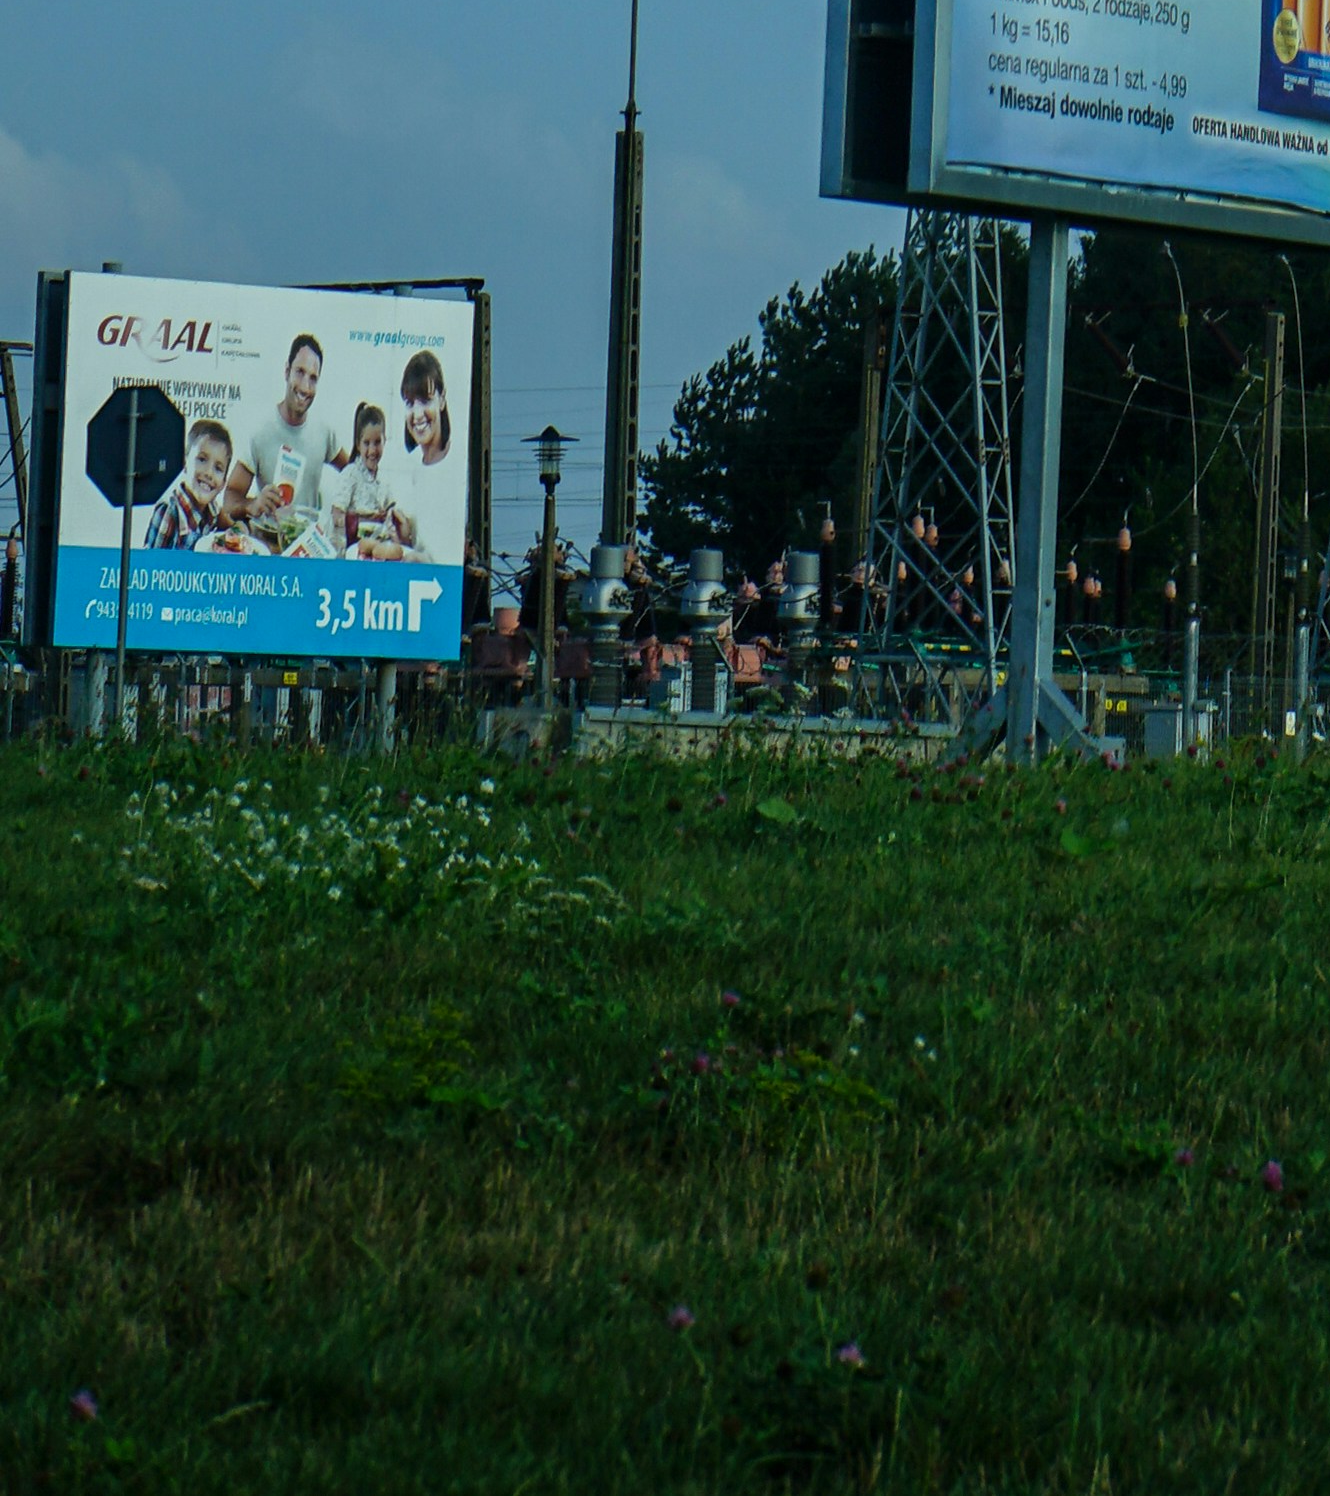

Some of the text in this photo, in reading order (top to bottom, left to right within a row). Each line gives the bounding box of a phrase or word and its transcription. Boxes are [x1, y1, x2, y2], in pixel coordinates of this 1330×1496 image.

[990, 12, 1070, 47] 1 kg 15,16
[1181, 11, 1190, 34] g
[988, 52, 1187, 99] cena regularna za 1 szt. 4,99
[1000, 85, 1174, 134] Mieszaj dowolnie rodzaje
[1192, 116, 1227, 138] OFERTA
[1230, 122, 1280, 148] HANDLOWA
[1283, 131, 1315, 154] WAŻNA
[1317, 139, 1328, 156] od
[97, 314, 213, 360] GRAAL
[349, 329, 445, 348] www.graalgroup.com
[173, 380, 227, 400] WPŁYWAMY
[228, 384, 241, 400] NA
[194, 402, 226, 419] POLSCE
[151, 569, 237, 595] PRODUKCYJNY
[240, 574, 278, 596] KORAL
[281, 576, 304, 598] S.A.
[174, 605, 248, 628] praca@koral.pl
[316, 588, 403, 635] 3,5 km
